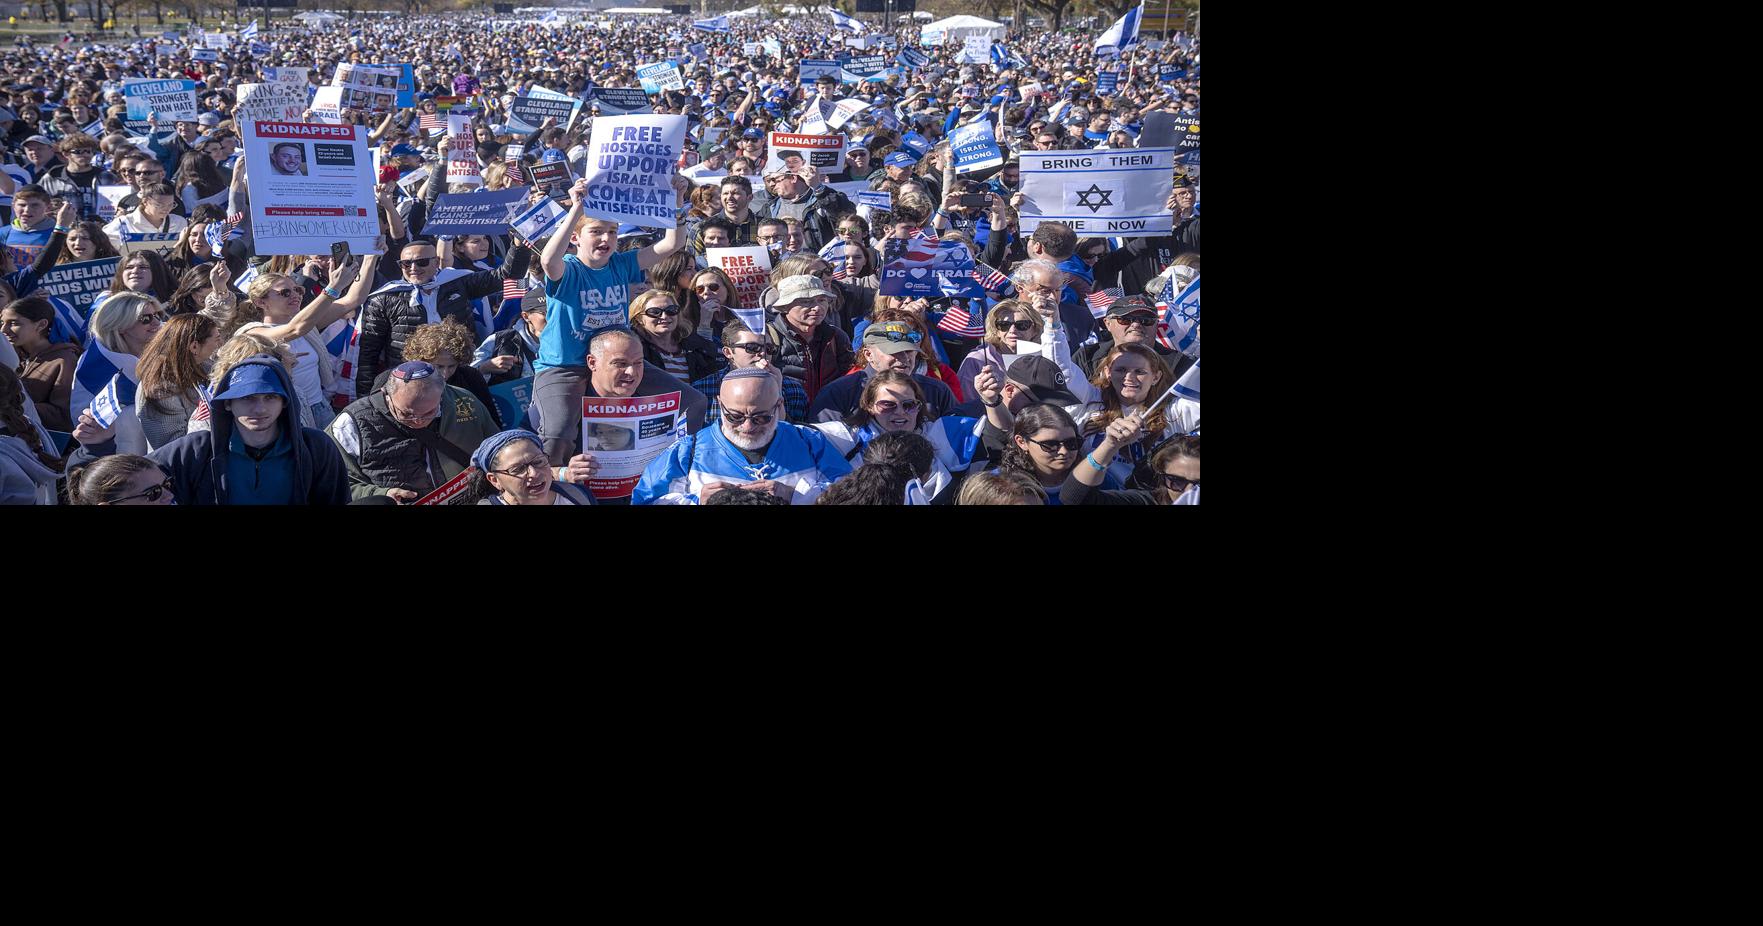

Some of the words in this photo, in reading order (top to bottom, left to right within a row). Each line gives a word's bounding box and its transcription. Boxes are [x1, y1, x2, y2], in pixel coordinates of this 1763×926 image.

[640, 62, 670, 76] CLEVELAND
[653, 70, 676, 80] STRONGER
[130, 81, 184, 95] CLEVELAND
[149, 93, 190, 104] STRONGER
[268, 97, 295, 107] THEM
[151, 104, 173, 113] THAN
[174, 102, 193, 111] HATE
[527, 101, 571, 110] CLEVELAND
[246, 107, 280, 120] HOME
[1174, 117, 1200, 125] Antis
[260, 124, 350, 136] KIDNAPPED
[612, 126, 663, 142] FREE
[450, 141, 473, 150] SUP
[776, 136, 840, 146] KIDNAPPED
[600, 142, 672, 156] HOSTAGES
[960, 144, 988, 153] ISRAEL
[960, 151, 995, 162] STRONG.
[1042, 157, 1092, 169] BRING
[1109, 156, 1153, 167] THEM
[452, 160, 477, 168] COM
[598, 155, 677, 175] UPPORT
[607, 172, 655, 186] ISRAEL
[588, 185, 670, 205] COMBAT
[435, 204, 491, 212] AMERICANS
[583, 200, 677, 218] ANTISEMITISM
[254, 220, 376, 236] #BRINGOMERHOME
[1064, 221, 1085, 230] ME
[1108, 220, 1146, 230] NOW
[721, 256, 754, 267] FREE
[38, 263, 119, 284] LEVELAN
[725, 266, 763, 275] OSTAGES
[932, 270, 973, 278] ISRAE
[43, 282, 82, 296] NDS
[84, 276, 113, 290] WIT
[580, 285, 627, 310] ISRAEL
[588, 400, 675, 414] KIDNAPPED
[427, 474, 472, 505] NAPPE
